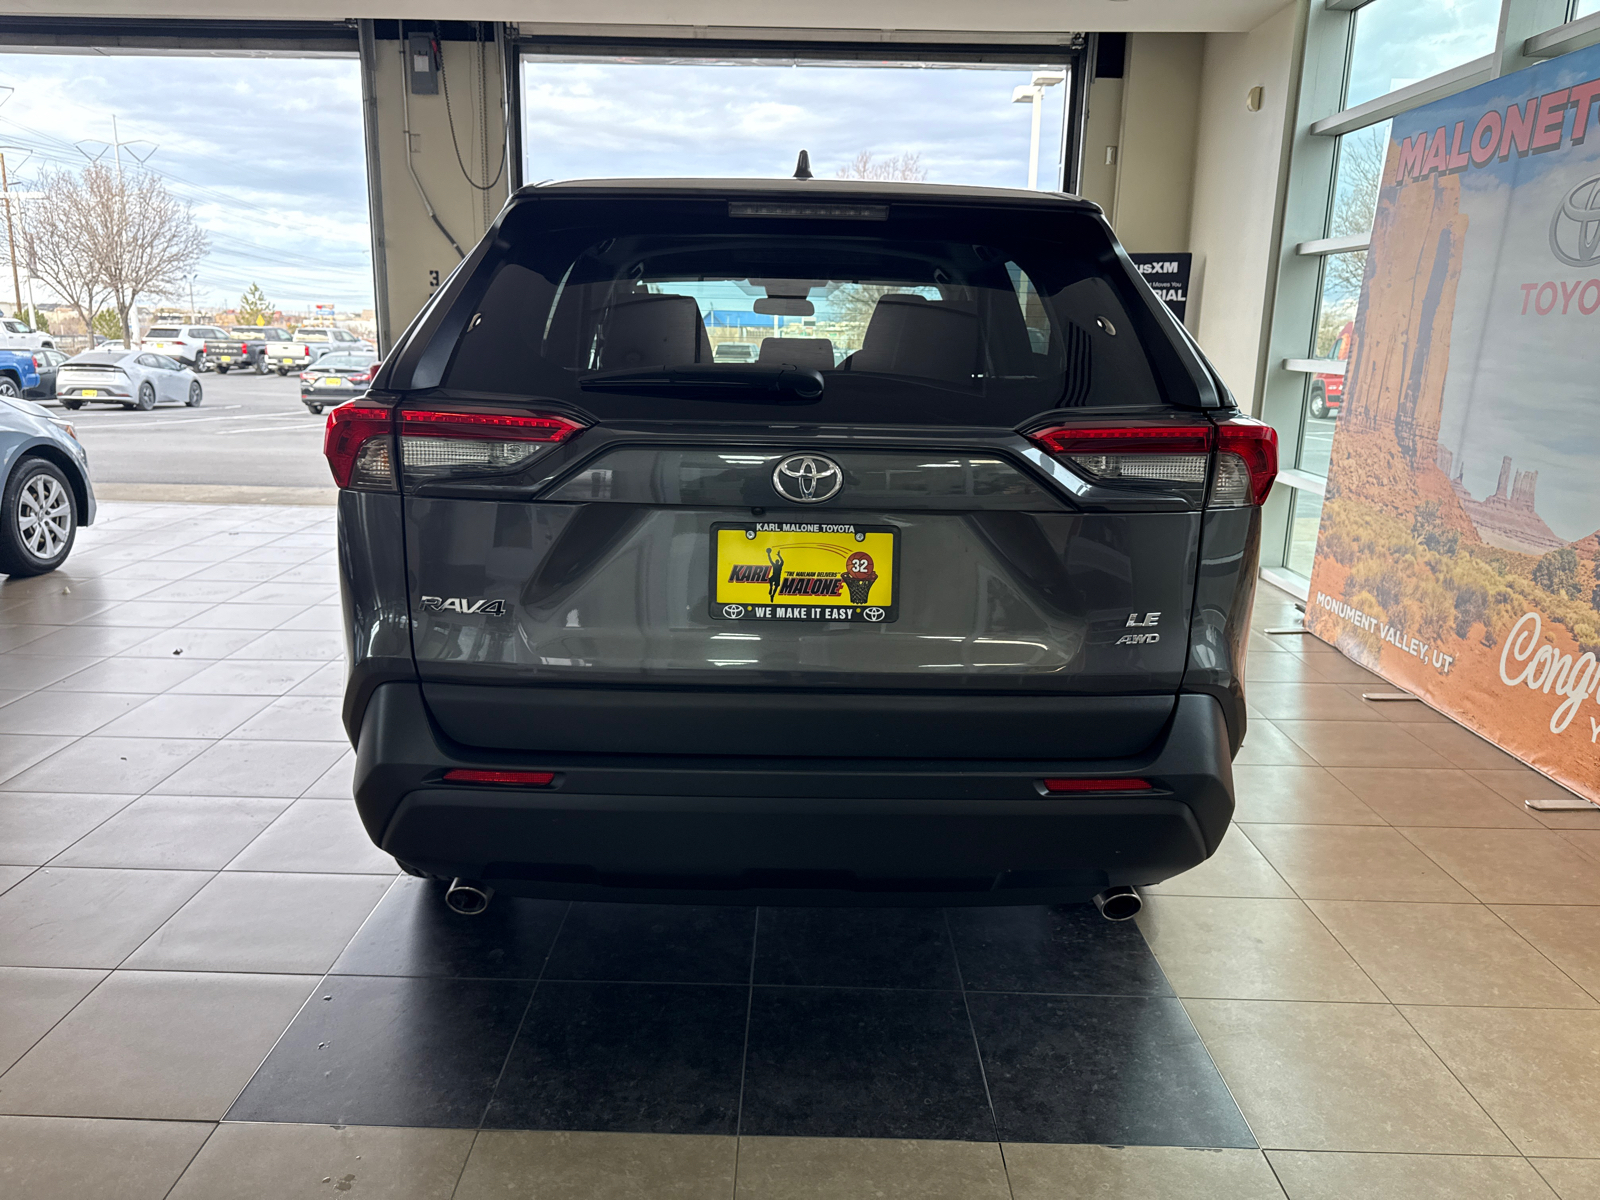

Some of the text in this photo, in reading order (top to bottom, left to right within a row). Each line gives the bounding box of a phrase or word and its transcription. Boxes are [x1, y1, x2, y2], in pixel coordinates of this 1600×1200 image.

[1396, 77, 1600, 187] MALONET
[429, 270, 439, 287] 3
[1520, 278, 1600, 316] TOYO
[756, 523, 855, 533] KARL MALONE TOYOTA
[728, 564, 773, 583] KARL
[851, 558, 868, 574] 32
[778, 577, 844, 597] MALONE
[418, 595, 506, 617] RAV4
[755, 606, 853, 620] WE MAKE IT EASY
[1126, 612, 1161, 627] LE
[1114, 633, 1160, 645] AWD
[1315, 591, 1454, 673] MONUMENT VALLEY, UT
